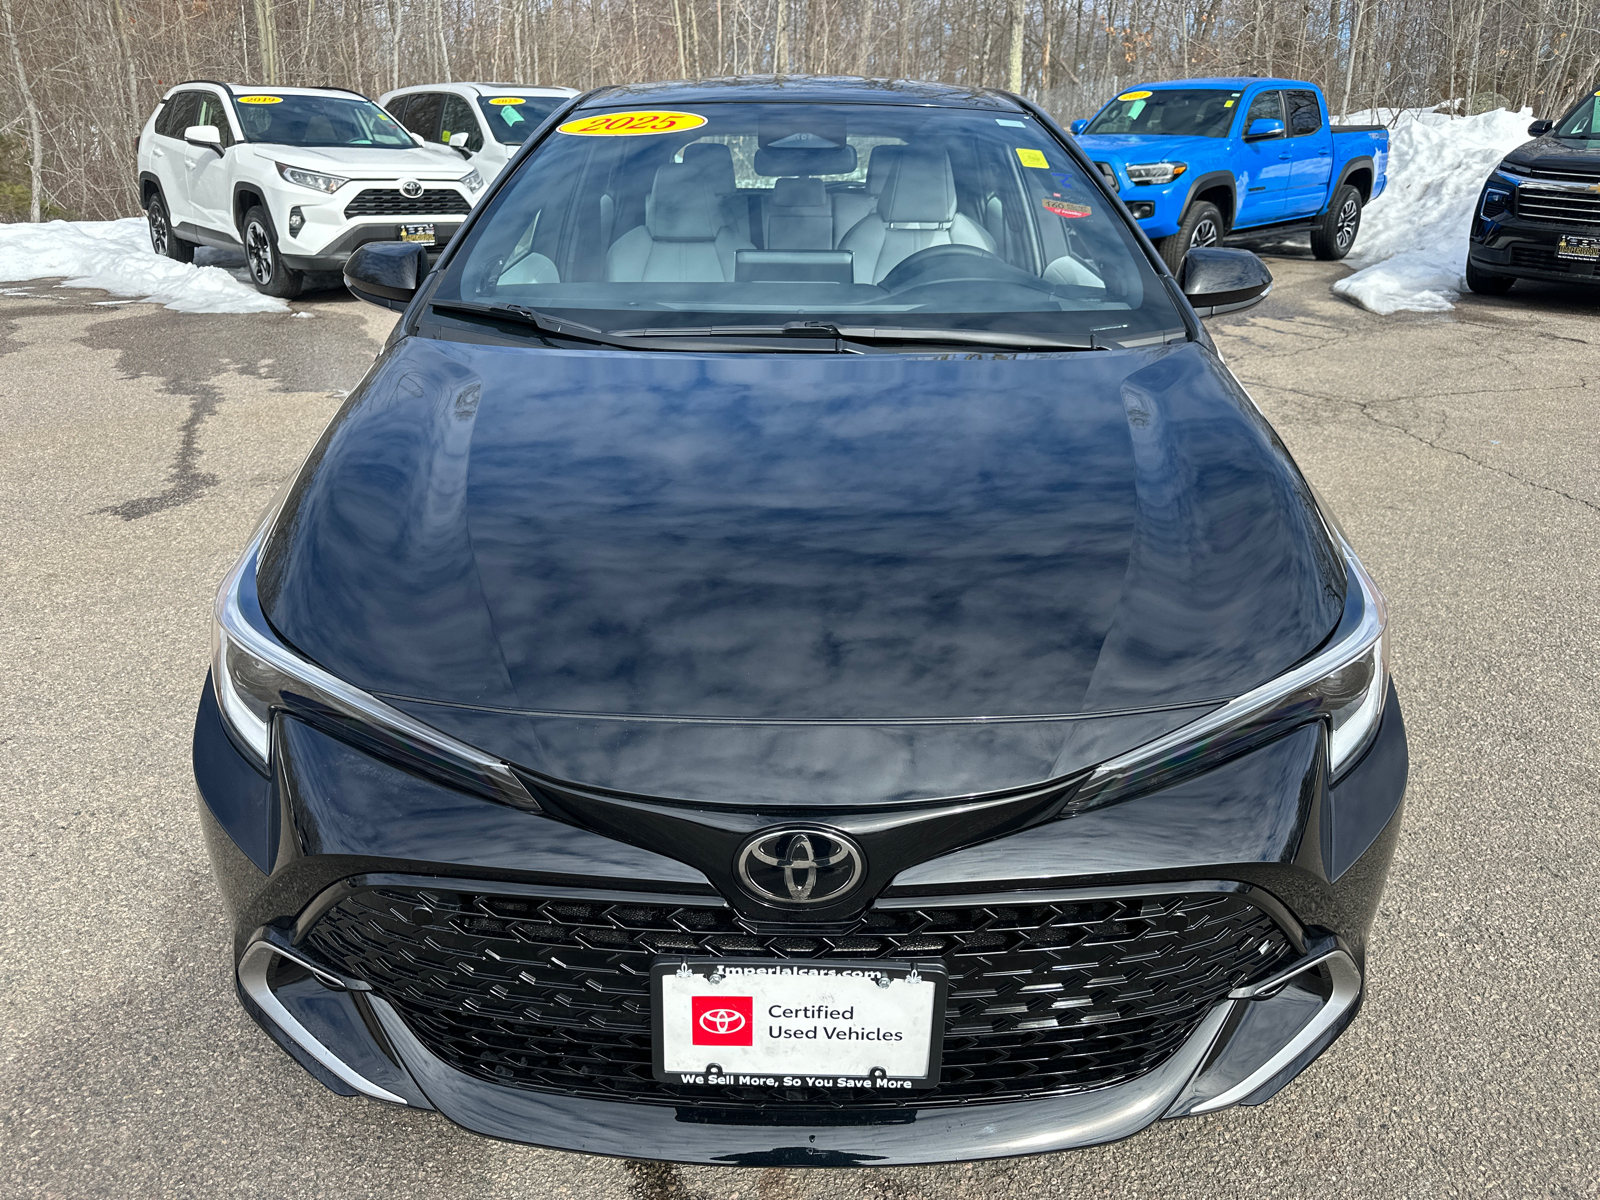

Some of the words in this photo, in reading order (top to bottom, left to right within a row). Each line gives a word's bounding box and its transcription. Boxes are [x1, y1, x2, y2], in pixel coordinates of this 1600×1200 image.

[577, 115, 686, 132] 2025
[717, 965, 882, 979] Imperialcars.com
[768, 1004, 854, 1020] Certified
[768, 1025, 818, 1039] Used
[822, 1026, 903, 1041] Vehicles
[680, 1074, 704, 1084] We
[708, 1074, 734, 1085] Sell
[739, 1076, 779, 1087] More,
[783, 1076, 802, 1087] So
[805, 1077, 833, 1087] You
[837, 1078, 872, 1088] Save
[876, 1078, 912, 1088] More
